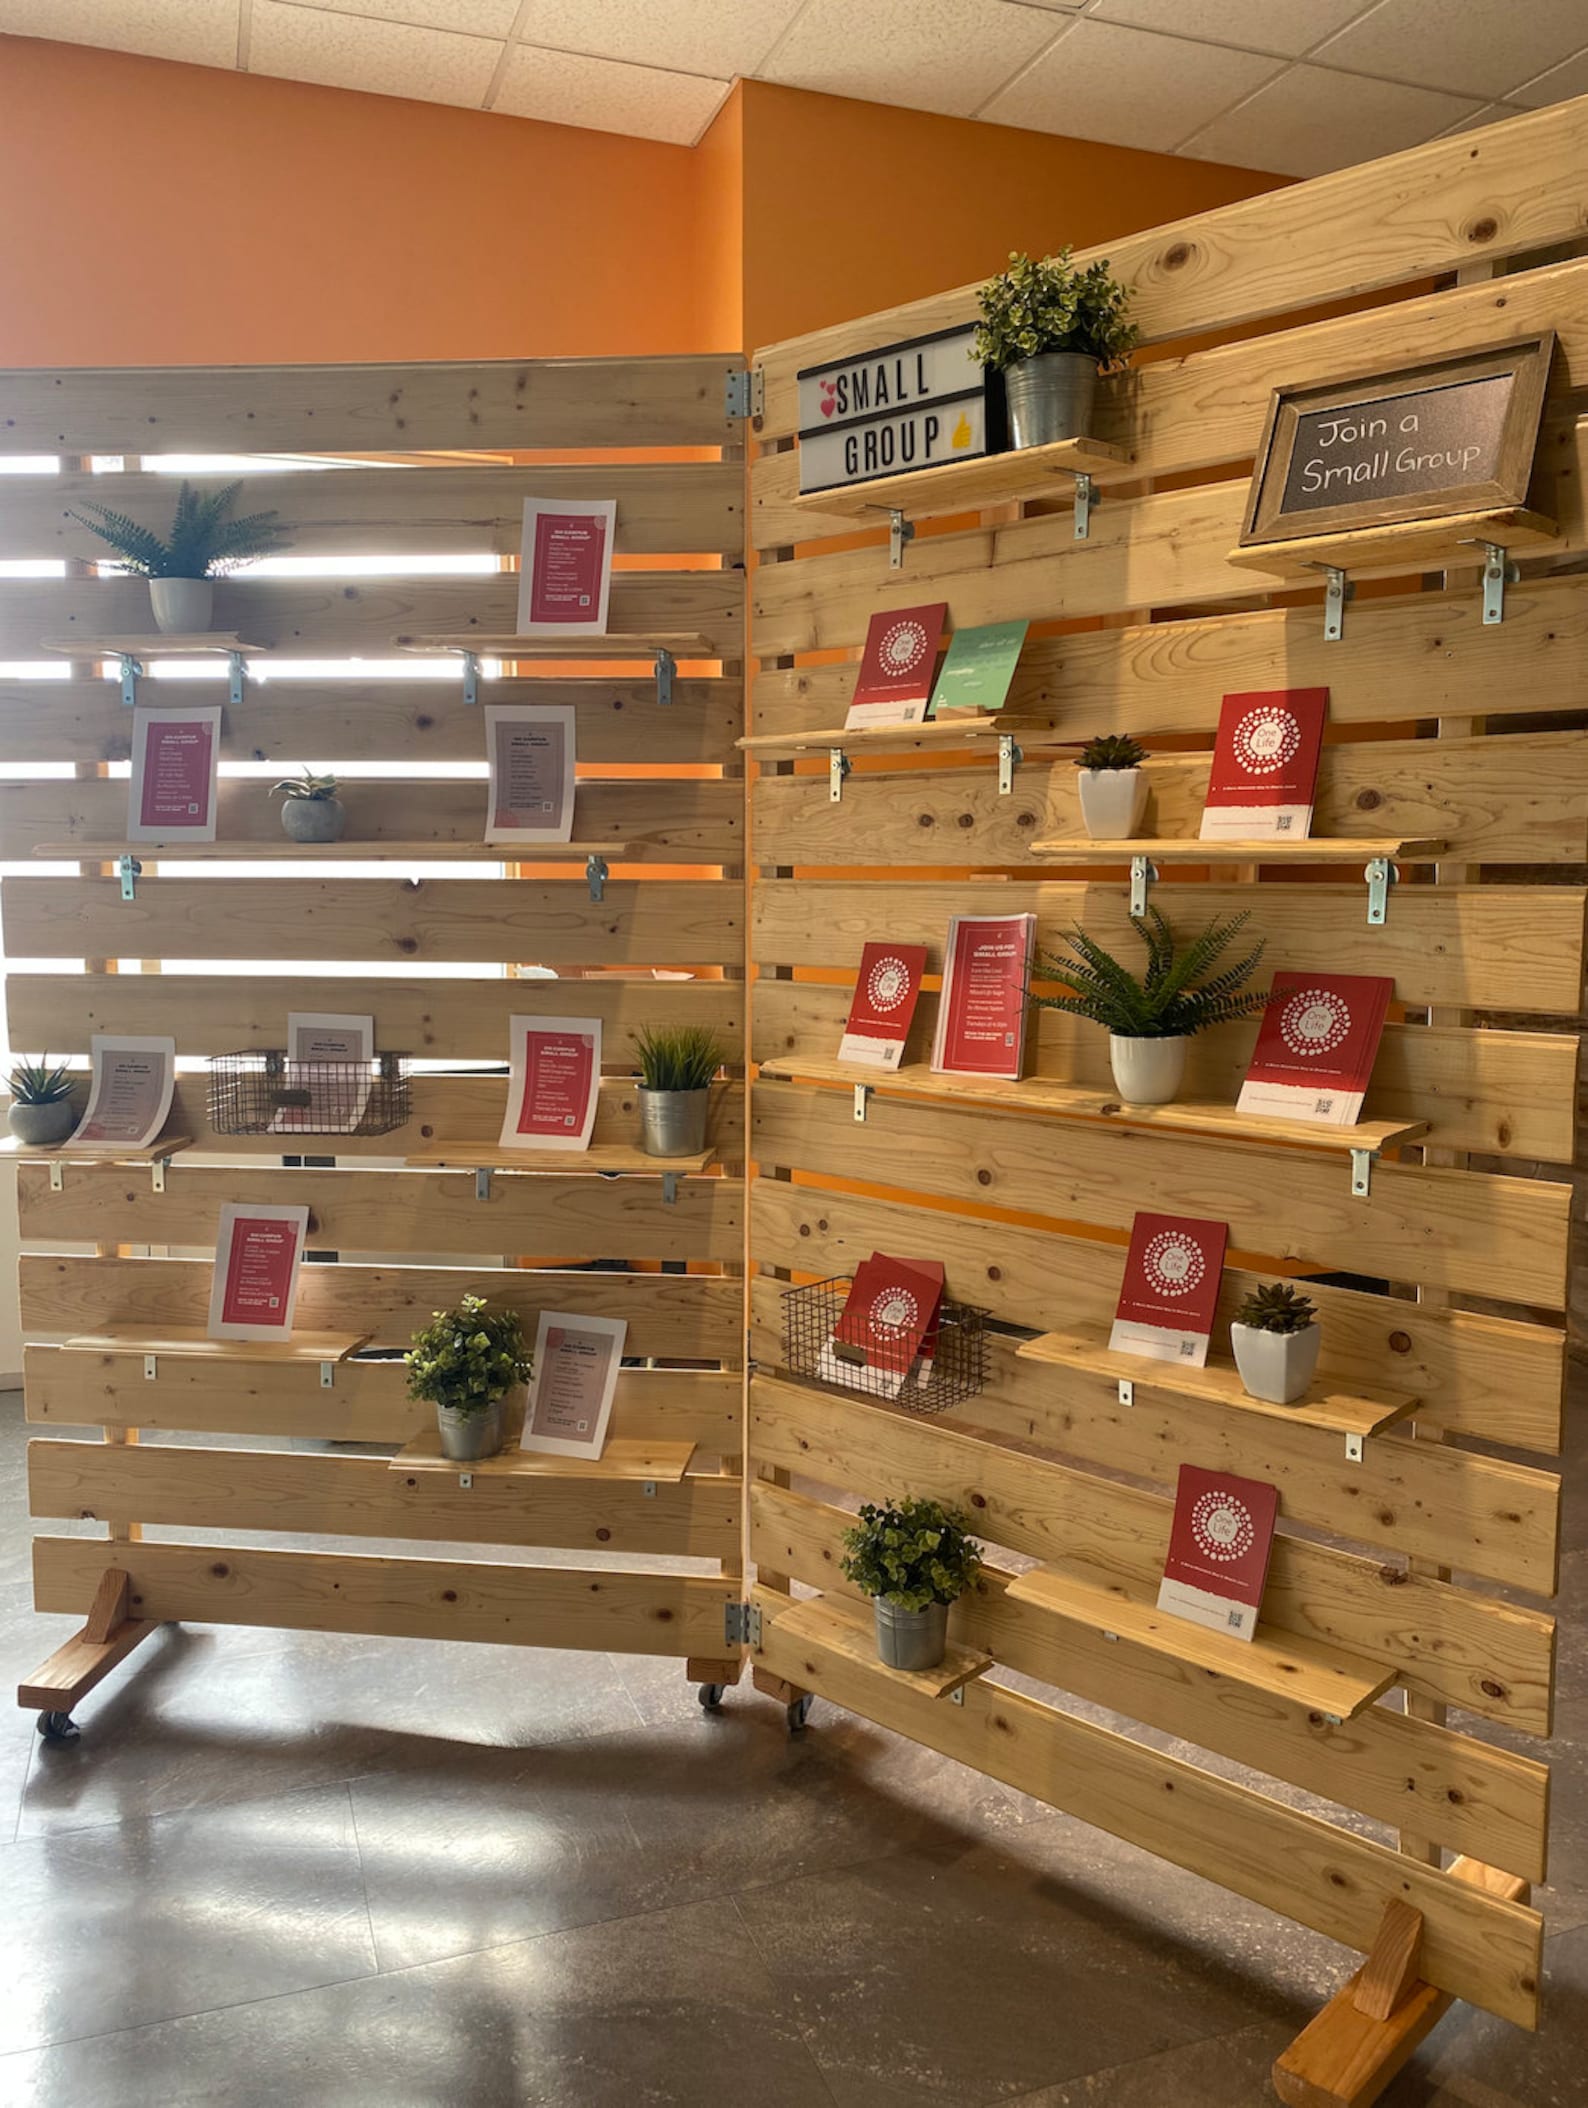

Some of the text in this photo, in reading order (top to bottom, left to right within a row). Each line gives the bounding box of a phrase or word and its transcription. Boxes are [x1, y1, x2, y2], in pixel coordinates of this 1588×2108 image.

[836, 353, 929, 414] SMALL
[1317, 414, 1418, 447] Join a
[845, 415, 939, 475] GROUP
[1301, 446, 1481, 492] Small Group
[1257, 728, 1276, 737] One
[1256, 738, 1276, 748] Life
[1307, 1010, 1327, 1020] One
[1304, 1020, 1325, 1032] Life
[1166, 1252, 1185, 1262] One
[1164, 1262, 1183, 1272] Life
[1214, 1514, 1233, 1526] One
[1212, 1524, 1231, 1537] Life
